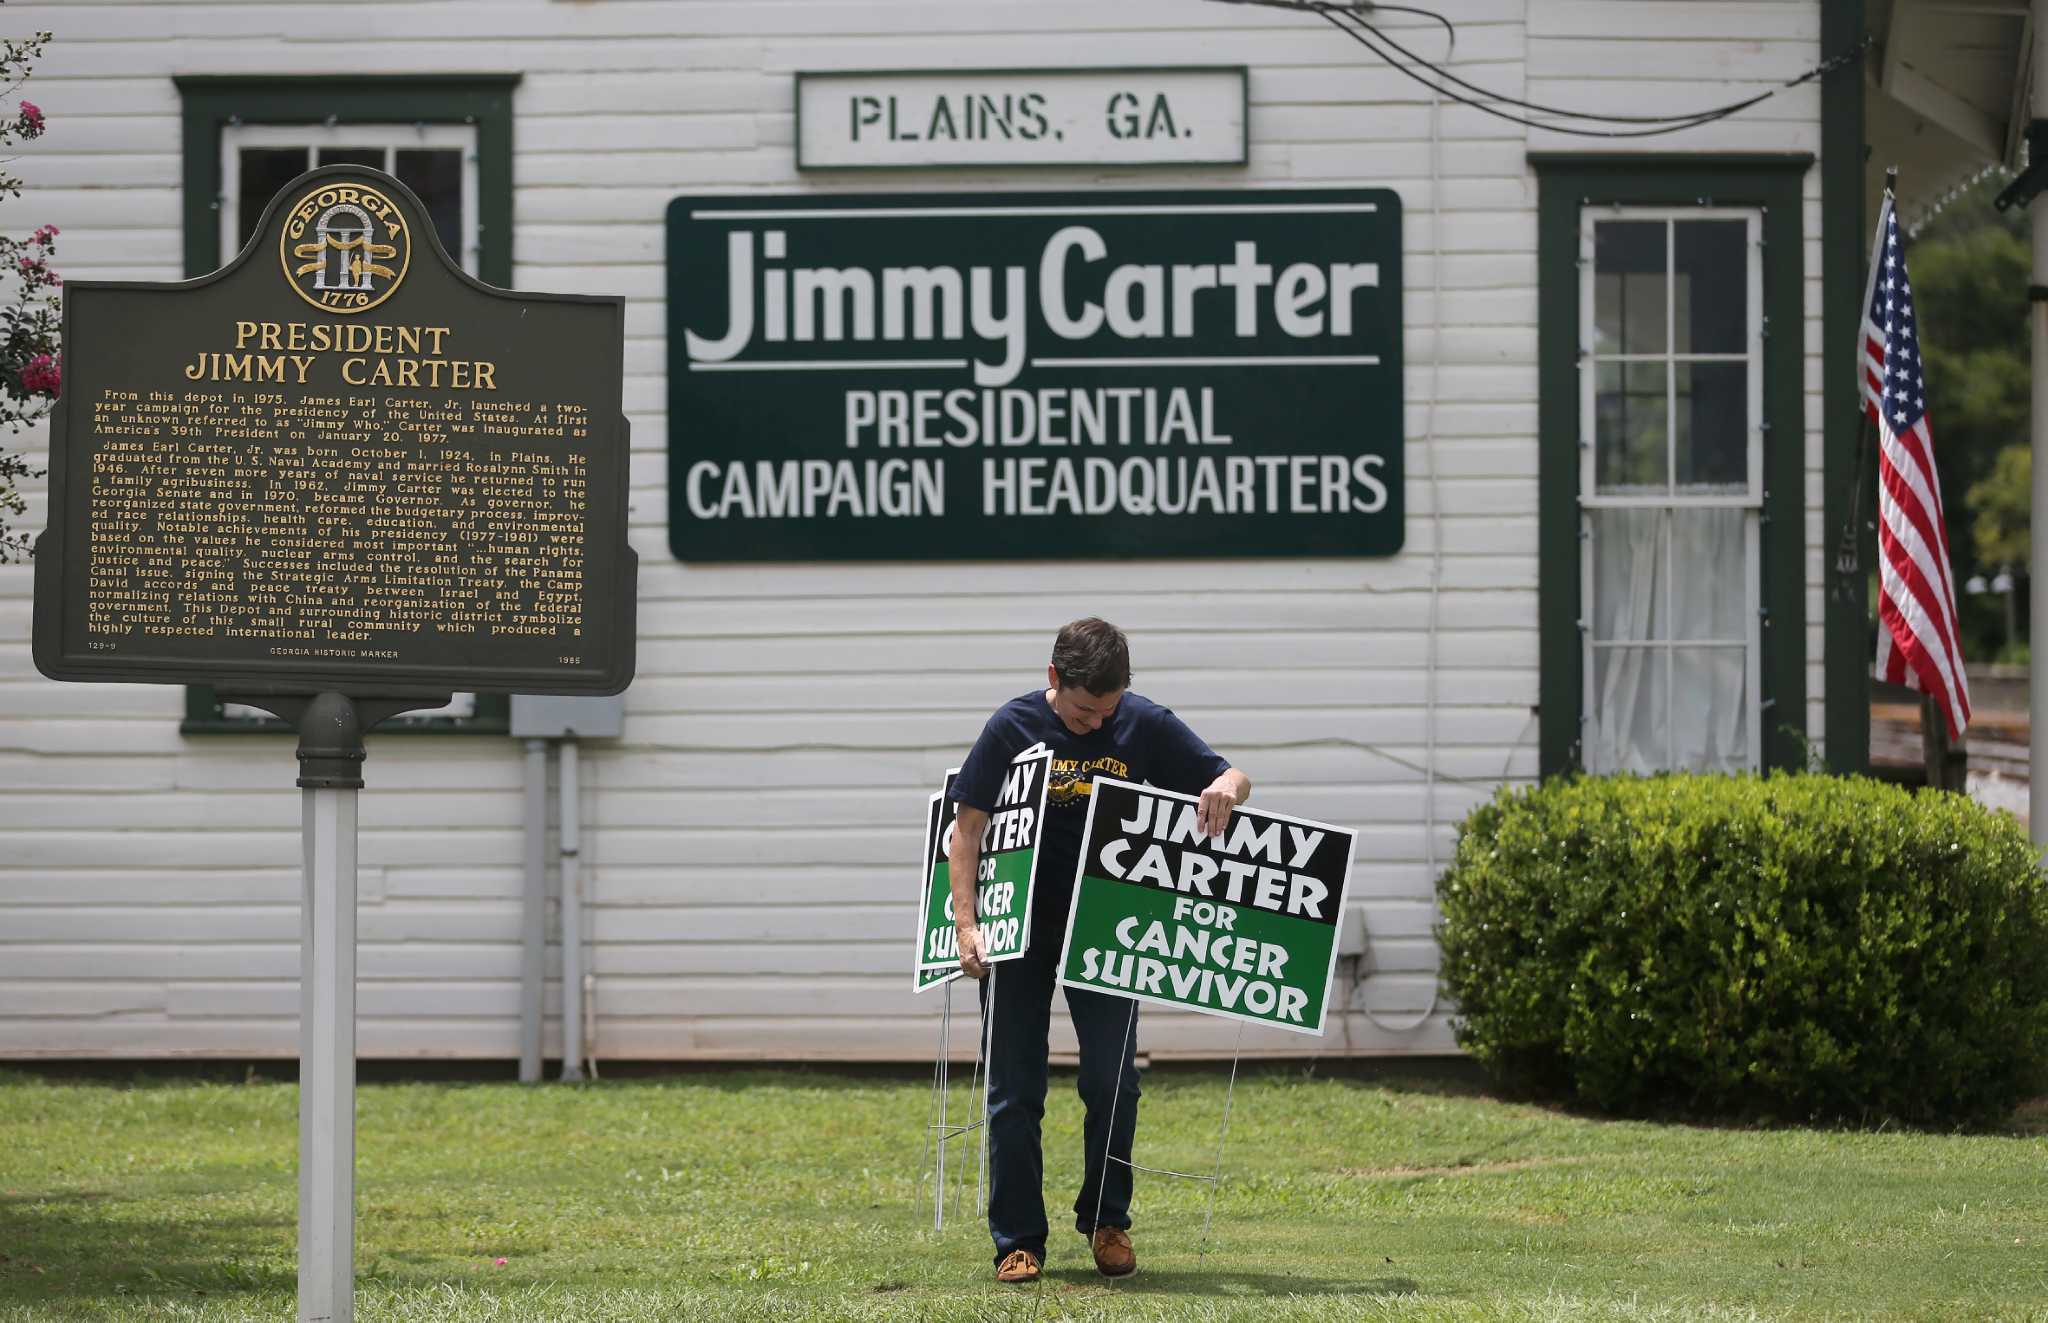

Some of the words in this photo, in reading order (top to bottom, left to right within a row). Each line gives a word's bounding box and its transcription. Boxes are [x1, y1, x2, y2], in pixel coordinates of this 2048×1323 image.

[1108, 93, 1194, 140] GA.
[289, 189, 401, 240] GEORGIA
[320, 291, 369, 307] 1776
[685, 230, 1027, 387] Jimmy
[1038, 225, 1380, 340] Carter
[235, 320, 451, 356] PRESIDENT
[185, 352, 316, 384] JIMMY
[342, 358, 497, 390] CARTER
[95, 402, 126, 414] year
[136, 401, 199, 416] campaign
[274, 405, 349, 421] presidency
[420, 409, 462, 421] United
[557, 413, 587, 425] first
[105, 389, 138, 400] From
[149, 390, 174, 401] this
[184, 391, 223, 406] depot
[299, 394, 340, 406] James
[349, 396, 375, 407] Earl
[471, 399, 530, 412] launched
[121, 412, 179, 425] unknown
[188, 414, 246, 427] referred
[398, 420, 442, 432] Carter
[484, 423, 563, 438] inaugurated
[845, 386, 1233, 448] PRESIDENTIAL
[171, 425, 202, 436] 39th
[216, 426, 278, 439] President
[318, 429, 371, 444] January
[103, 439, 144, 451] James
[152, 441, 179, 452] Earl
[307, 445, 338, 457] born
[351, 447, 408, 459] October
[93, 450, 162, 466] graduated
[169, 453, 200, 464] from
[268, 456, 304, 467] Naval
[312, 457, 371, 472] Academy
[407, 460, 460, 472] married
[466, 462, 526, 477] Rosalynn
[532, 463, 569, 475] Smith
[141, 463, 177, 475] After
[186, 467, 225, 477] seven
[234, 469, 268, 478] more
[278, 470, 316, 482] years
[348, 469, 383, 481] naval
[392, 471, 442, 483] service
[474, 473, 534, 486] returned
[92, 485, 146, 500] Georgia
[156, 486, 202, 499] Senate
[209, 488, 232, 500] and
[314, 491, 365, 503] became
[111, 474, 152, 489] family
[344, 481, 387, 496] Jimmy
[397, 482, 442, 494] Carter
[482, 485, 532, 497] elected
[686, 458, 946, 519] CAMPAIGN
[982, 454, 1388, 517] HEADQUARTERS
[92, 496, 174, 512] reorganized
[179, 500, 212, 511] state
[305, 502, 366, 515] reformed
[370, 504, 391, 516] the
[396, 505, 465, 521] budgetary
[533, 509, 584, 524] improv-
[117, 511, 147, 520] race
[264, 513, 306, 525] health
[452, 518, 475, 530] and
[488, 519, 584, 533] environmental
[91, 531, 130, 542] based
[163, 533, 184, 544] the
[194, 534, 236, 546] values
[271, 536, 344, 549] considered
[353, 539, 384, 550] most
[392, 540, 458, 555] important
[157, 521, 209, 533] Notable
[217, 523, 307, 536] achievements
[342, 526, 360, 538] his
[371, 527, 448, 543] presidency
[460, 530, 538, 543] (1977-1981)
[550, 535, 584, 544] were
[90, 553, 139, 568] justice
[148, 555, 172, 566] and
[243, 558, 310, 570] Successes
[316, 560, 372, 572] included
[379, 562, 401, 573] the
[408, 562, 476, 575] resolution
[504, 565, 527, 577] the
[533, 566, 582, 579] Panama
[91, 542, 187, 556] environmental
[261, 547, 312, 559] nuclear
[323, 551, 354, 561] arms
[434, 552, 458, 564] and
[470, 553, 492, 565] the
[504, 554, 549, 566] search
[562, 556, 584, 567] for
[90, 565, 127, 577] Canal
[184, 568, 234, 583] signing
[242, 569, 263, 581] the
[271, 570, 334, 586] Strategic
[344, 572, 377, 584] Arms
[385, 574, 452, 586] Limitation
[520, 578, 540, 589] the
[547, 578, 583, 593] Camp
[90, 576, 128, 588] David
[144, 578, 198, 590] accords
[211, 580, 234, 591] and
[251, 583, 290, 596] peace
[306, 584, 348, 597] treaty
[367, 585, 424, 597] between
[440, 587, 478, 599] Israel
[496, 589, 519, 600] and
[90, 587, 170, 603] normalizing
[178, 590, 239, 603] relations
[248, 592, 276, 604] with
[285, 593, 323, 605] China
[331, 595, 354, 606] and
[364, 596, 465, 612] reorganization
[500, 600, 521, 611] the
[534, 601, 582, 613] federal
[89, 610, 110, 622] the
[122, 611, 170, 624] culture
[210, 614, 233, 626] this
[250, 615, 284, 627] small
[299, 617, 332, 629] rural
[348, 618, 421, 634] community
[436, 621, 475, 633] which
[492, 623, 556, 638] produced
[183, 602, 212, 613] This
[220, 603, 260, 618] Depot
[268, 604, 292, 616] and
[299, 605, 380, 621] surrounding
[389, 608, 442, 620] historic
[451, 610, 502, 622] district
[512, 612, 582, 627] symbolize
[88, 621, 132, 636] highly
[145, 623, 214, 638] respected
[226, 625, 315, 639] international
[269, 647, 310, 656] GEORGIA
[314, 648, 356, 657] HISTORIC
[360, 650, 399, 659] MARKER
[1120, 794, 1326, 869] JIMMY
[977, 857, 997, 881] OR
[1099, 837, 1330, 920] CARTER
[1172, 896, 1238, 932] FOR
[1115, 915, 1290, 980] CANCER
[1079, 946, 1309, 1023] SURVIVOR
